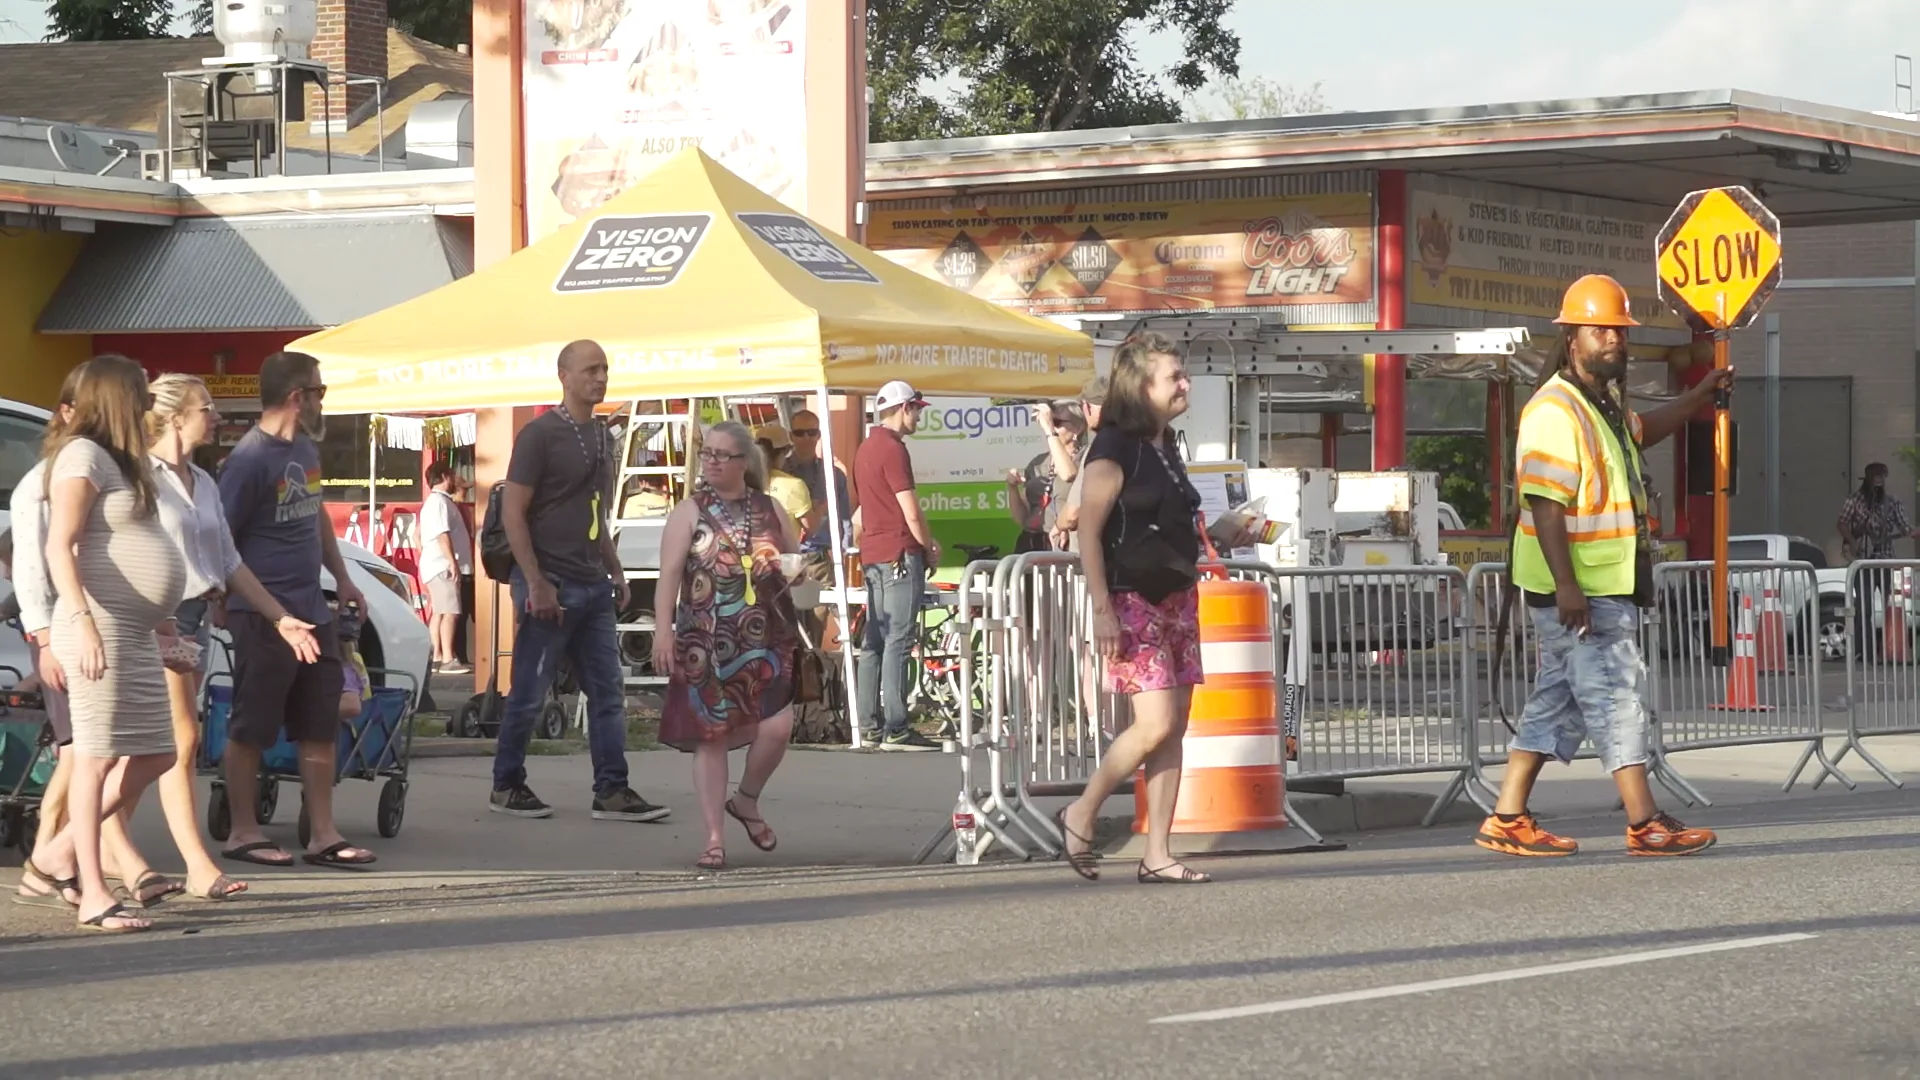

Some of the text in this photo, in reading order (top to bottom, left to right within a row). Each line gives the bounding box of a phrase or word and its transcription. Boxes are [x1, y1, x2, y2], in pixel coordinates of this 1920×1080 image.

[641, 137, 675, 154] ALSO
[892, 219, 955, 230] SHOWCASING
[956, 218, 969, 229] ON
[1103, 211, 1169, 222] MICRO-BREW
[1468, 203, 1507, 223] STEVE'S
[1586, 219, 1620, 236] GLUTEN
[1622, 223, 1644, 240] FREE
[597, 227, 698, 247] VISION
[753, 225, 824, 243] VISION
[1243, 216, 1357, 270] Coors
[1458, 226, 1465, 241] &
[1468, 228, 1484, 244] KID
[1540, 238, 1574, 255] HEATED
[1608, 245, 1622, 261] WE
[575, 245, 684, 270] ZERO
[774, 243, 848, 263] ZERO
[1072, 246, 1107, 270] $11.50
[1155, 241, 1225, 266] Corona
[1672, 230, 1760, 289] SLOW
[1078, 271, 1104, 281] PITCHER
[1498, 256, 1531, 275] THROW
[1533, 261, 1556, 277] YOUR
[1246, 267, 1348, 296] LIGHT
[1449, 275, 1471, 299] TRY
[1473, 279, 1480, 300] A
[377, 364, 415, 384] NO
[422, 358, 495, 382] MORE
[613, 350, 716, 373] DEATHS
[876, 344, 897, 365] NO
[900, 345, 939, 366] MORE
[942, 345, 996, 369] TRAFFIC
[1000, 349, 1048, 373] DEATHS
[962, 468, 977, 476] ship
[919, 491, 971, 511] othes
[977, 492, 990, 509] &
[1463, 551, 1474, 564] on
[1477, 548, 1502, 562] Travel
[1283, 685, 1295, 736] COLORADO
